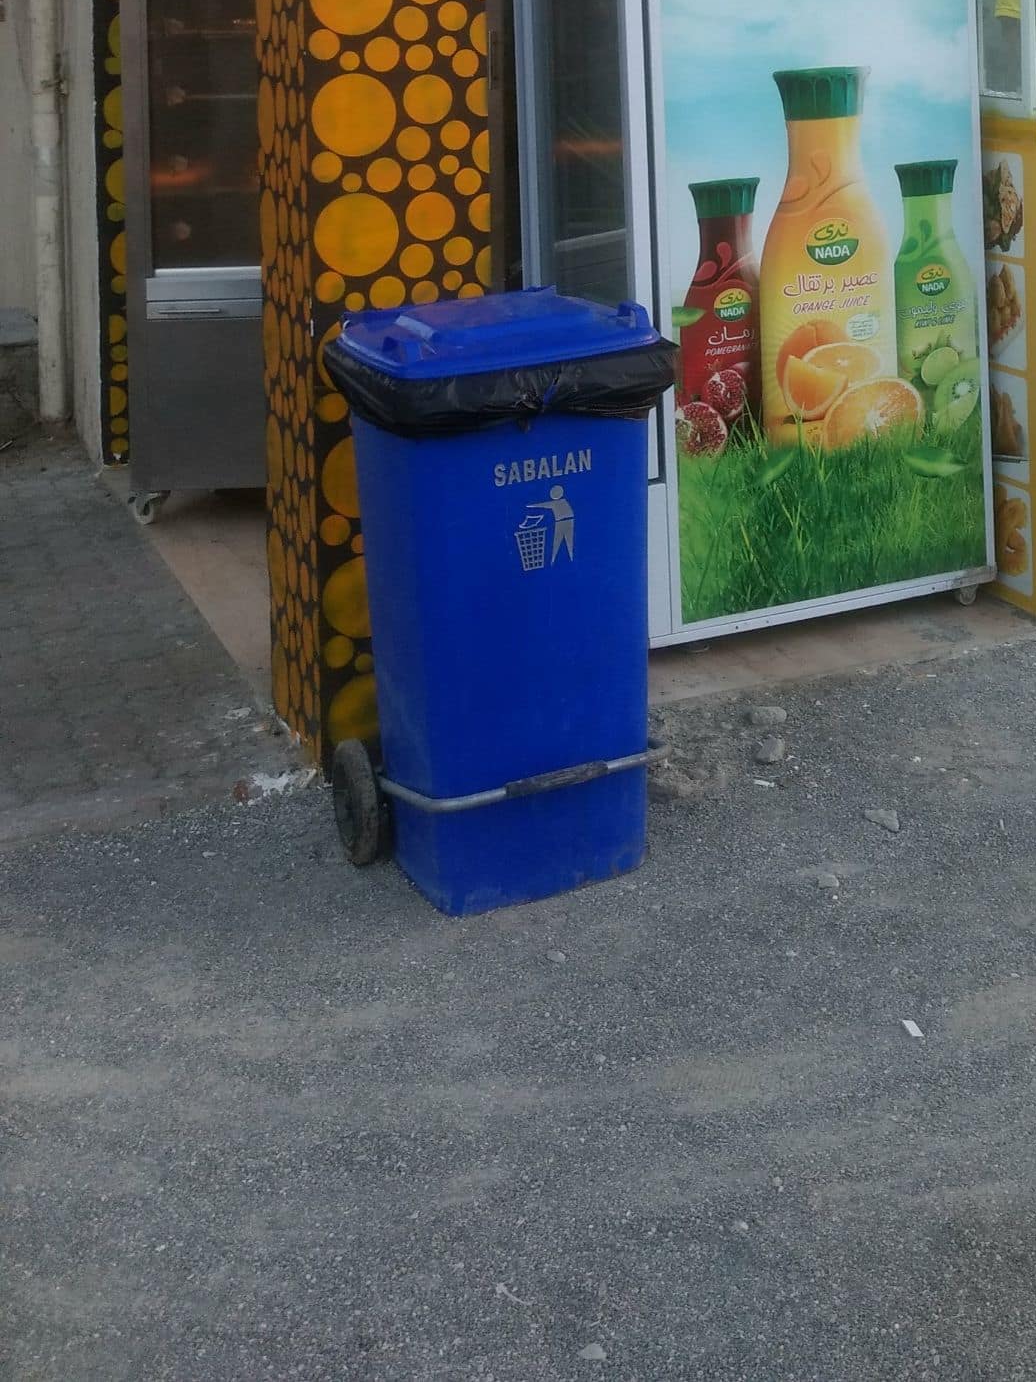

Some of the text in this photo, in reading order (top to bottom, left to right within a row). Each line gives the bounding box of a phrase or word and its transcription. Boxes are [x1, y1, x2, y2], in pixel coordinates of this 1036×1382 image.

[815, 244, 851, 259] NADA
[783, 274, 834, 296] برتقال
[921, 282, 945, 292] NADA
[720, 306, 745, 318] NADA
[793, 295, 871, 315] ORANGE JUICE
[494, 448, 592, 487] SABALAN
